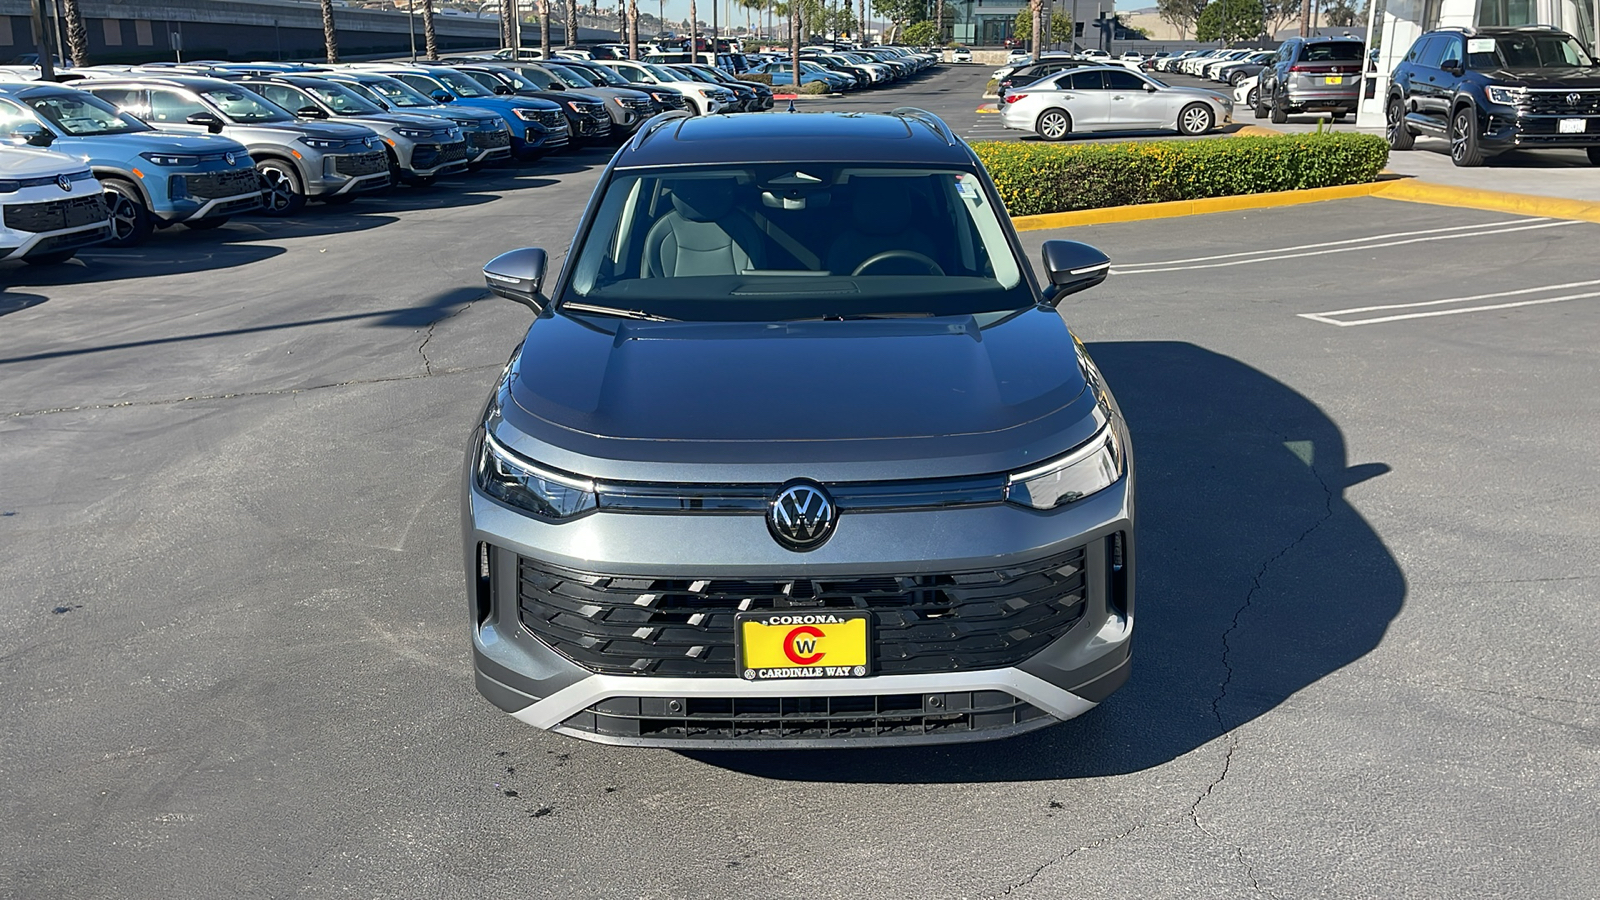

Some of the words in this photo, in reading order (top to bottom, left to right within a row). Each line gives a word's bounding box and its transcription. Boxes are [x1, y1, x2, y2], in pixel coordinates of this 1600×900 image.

[769, 615, 838, 625] CORONA
[758, 668, 824, 678] CARDINALE
[826, 667, 851, 676] WAY
